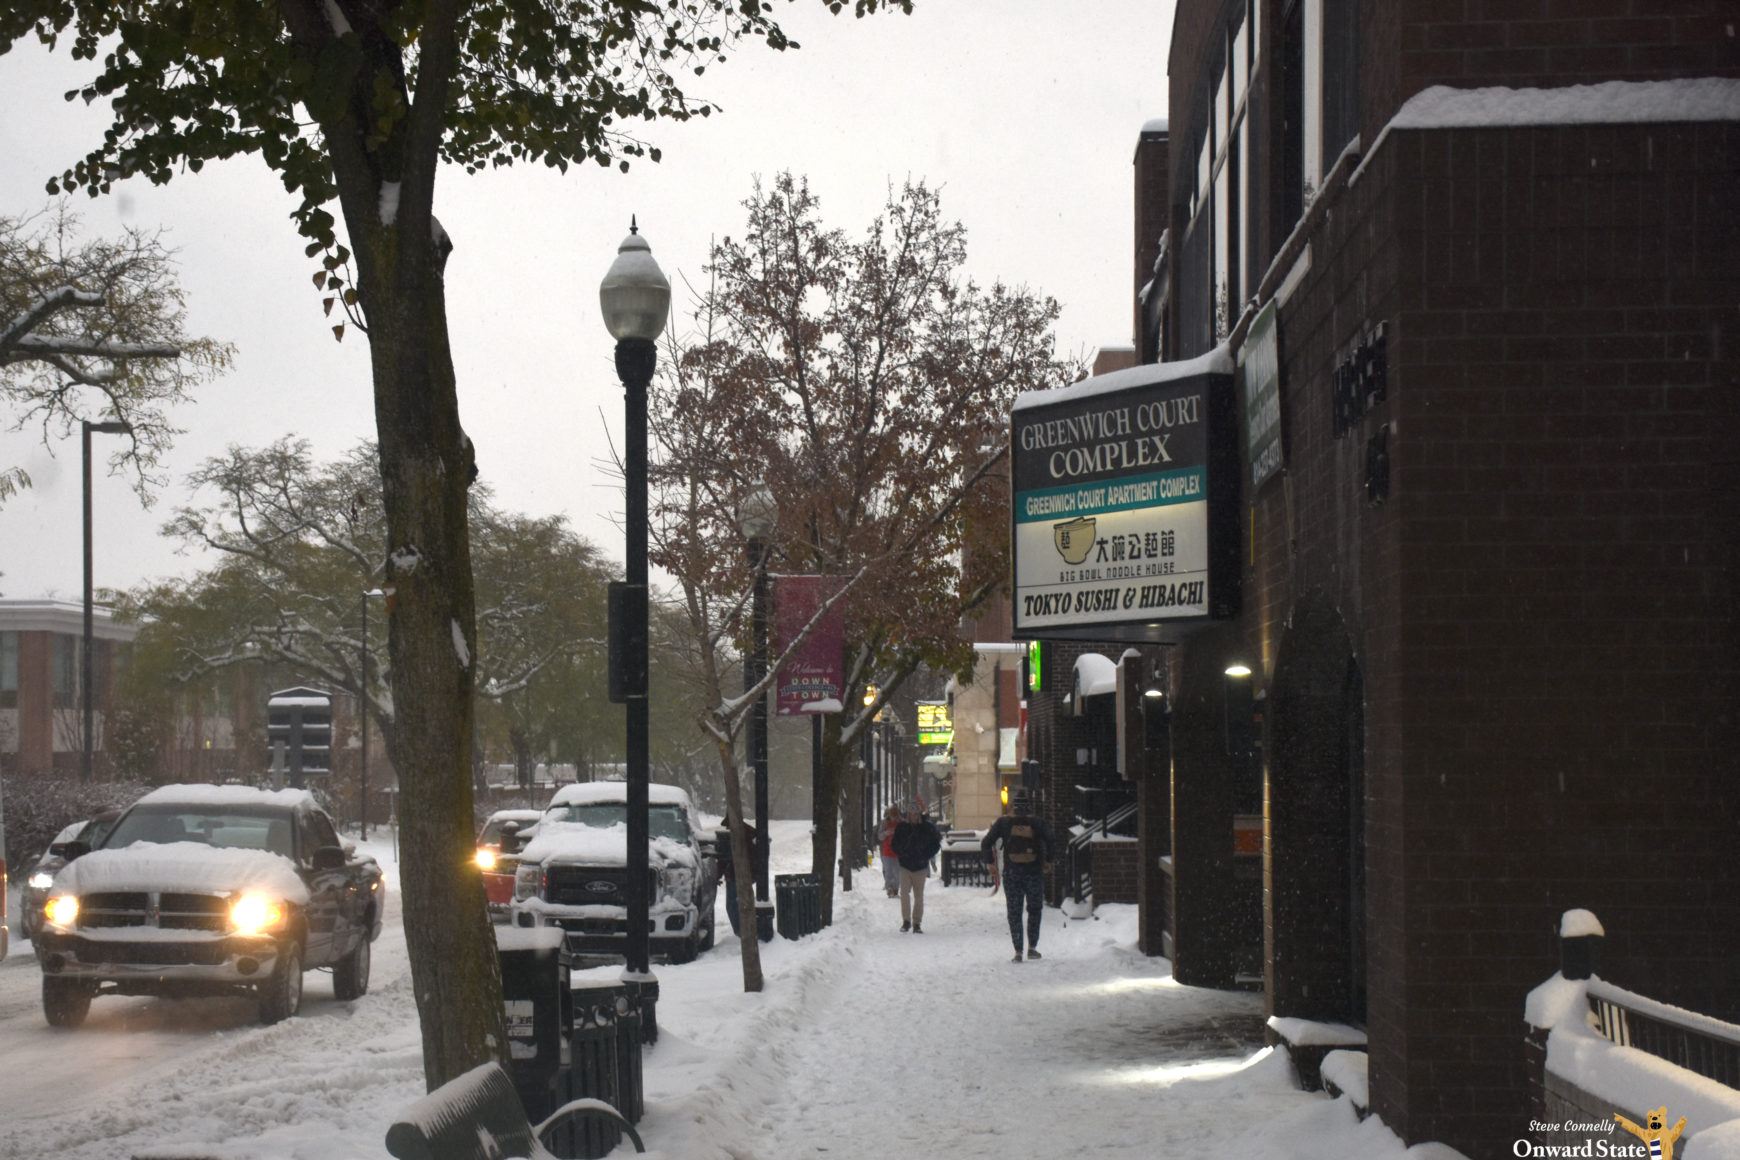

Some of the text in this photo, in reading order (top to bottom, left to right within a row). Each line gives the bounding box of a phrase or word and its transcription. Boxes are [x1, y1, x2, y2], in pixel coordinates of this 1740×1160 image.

[1021, 395, 1200, 451] GREENWICH COURT
[1049, 434, 1173, 478] COMPLEX
[1026, 475, 1200, 516] GREENWICH COURT APARTMENT COMPLEX
[1060, 562, 1175, 582] BIG BOWL NOODLE HOUSE
[1024, 581, 1205, 616] TOKYO SUSHI & HIBACHI
[791, 677, 830, 685] DOWN
[791, 691, 829, 699] TOWN
